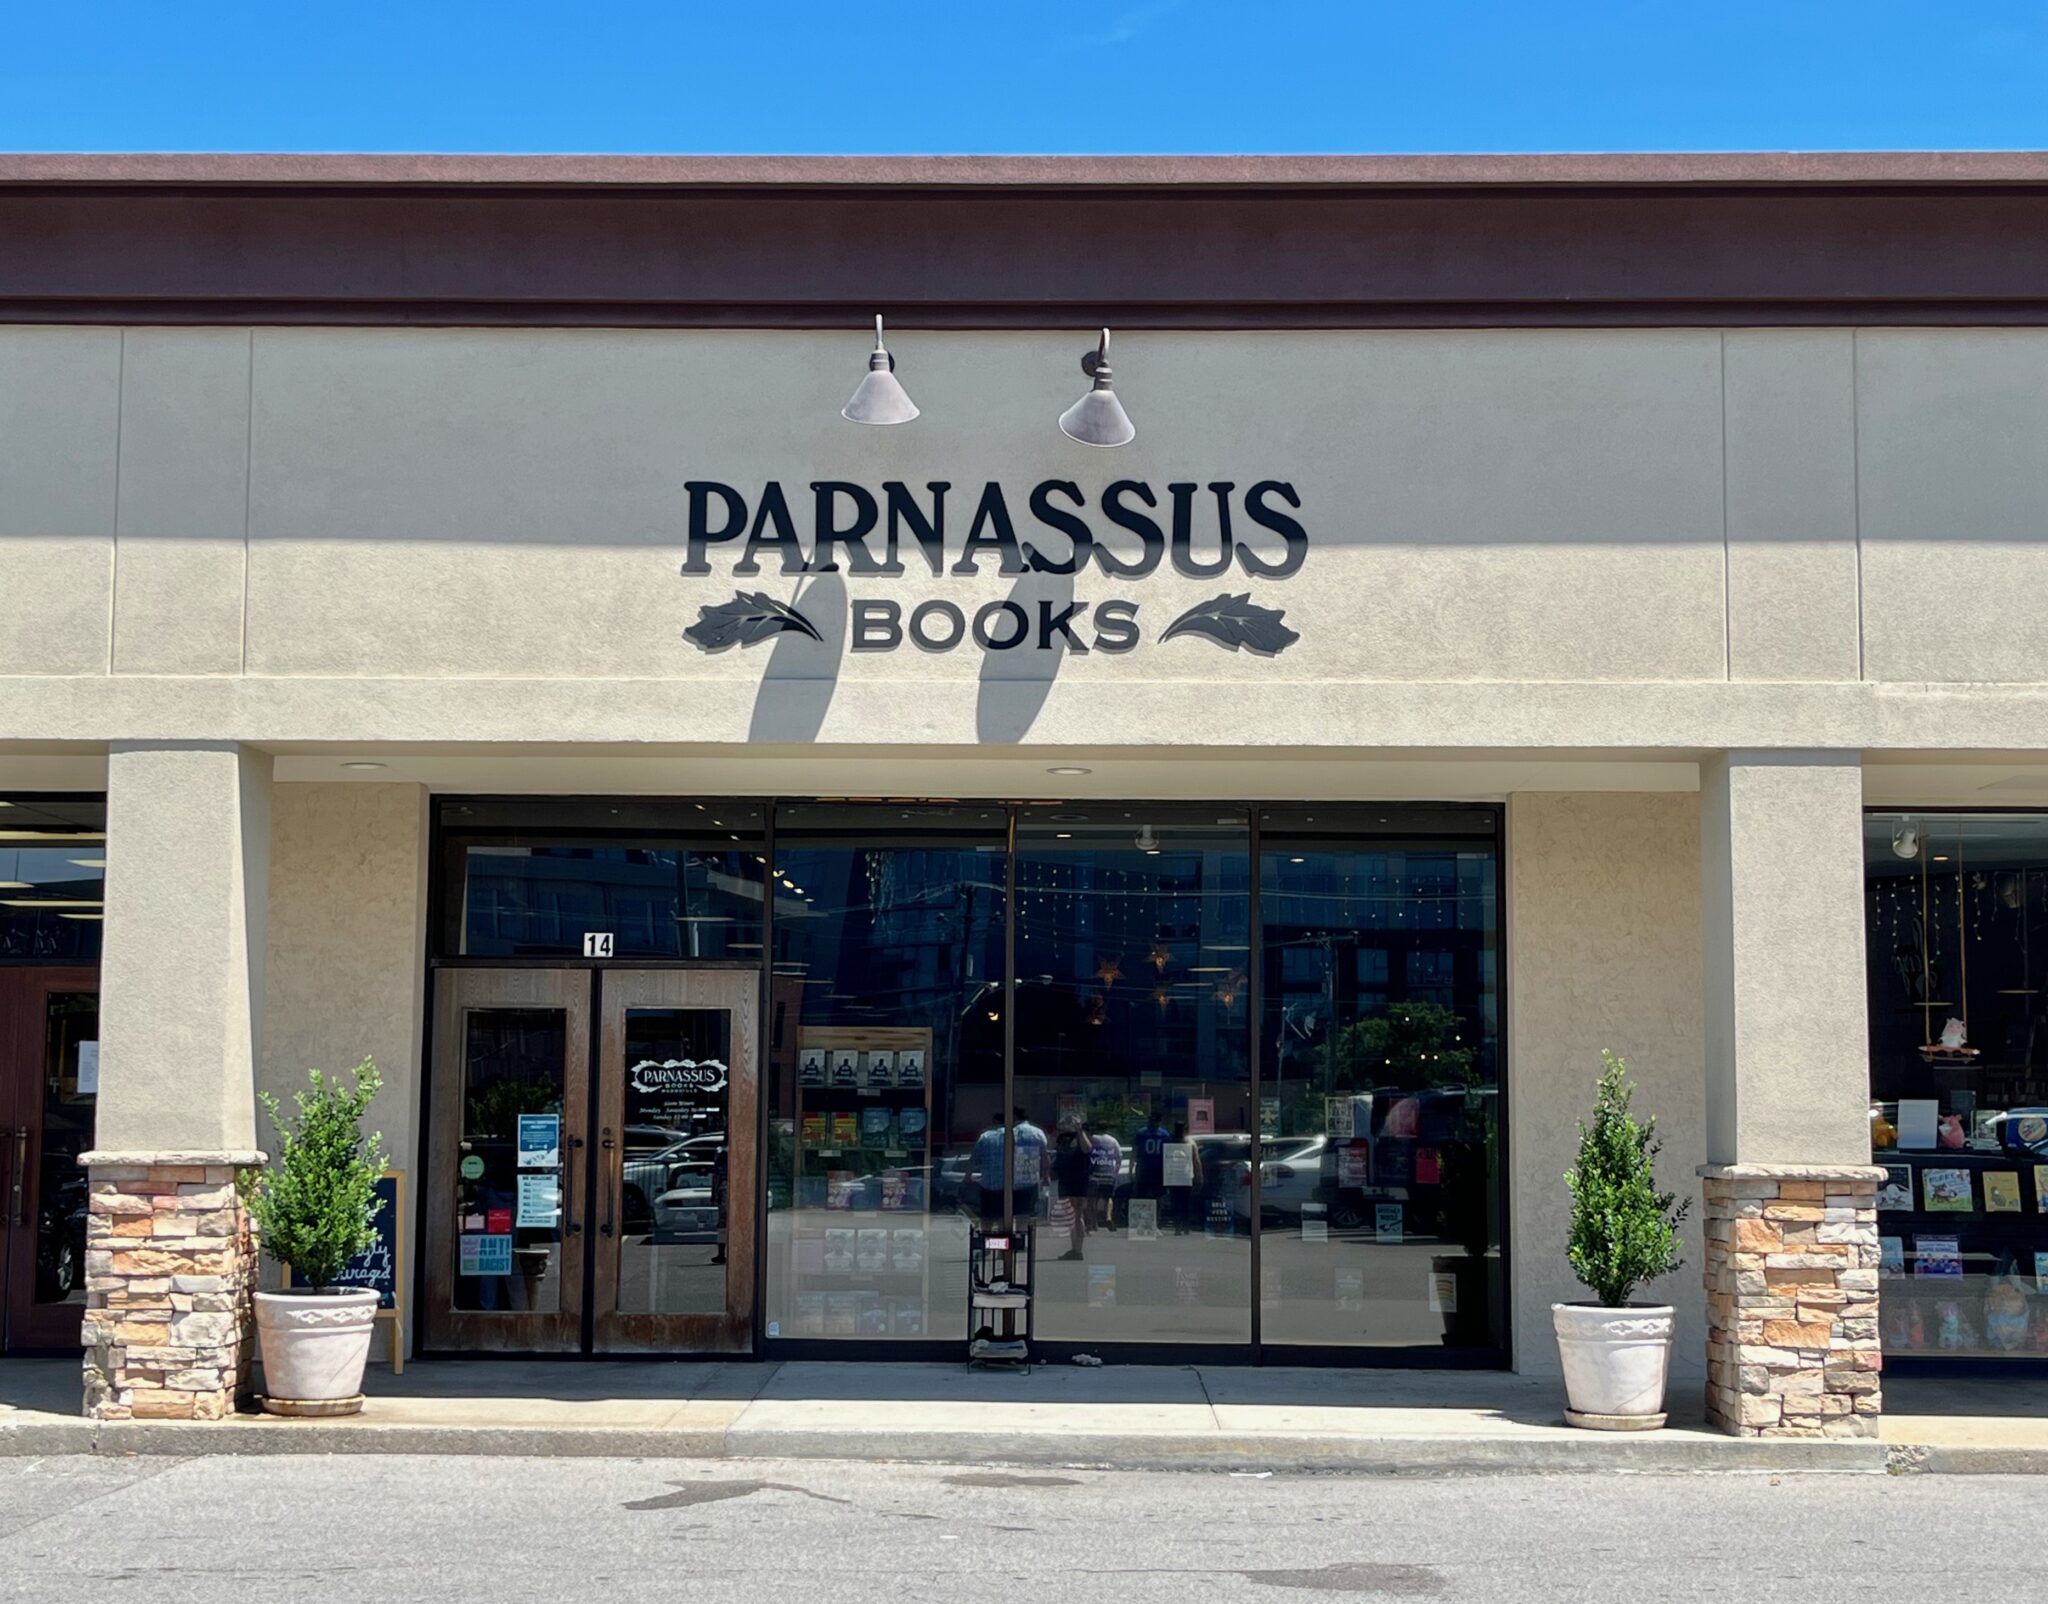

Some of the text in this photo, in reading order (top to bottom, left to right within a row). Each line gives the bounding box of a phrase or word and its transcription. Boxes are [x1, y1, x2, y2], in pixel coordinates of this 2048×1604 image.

[681, 479, 1308, 578] PARNASSUS
[851, 599, 1140, 655] BOOKS
[588, 934, 611, 956] 14
[644, 1069, 715, 1083] PARNASSUS
